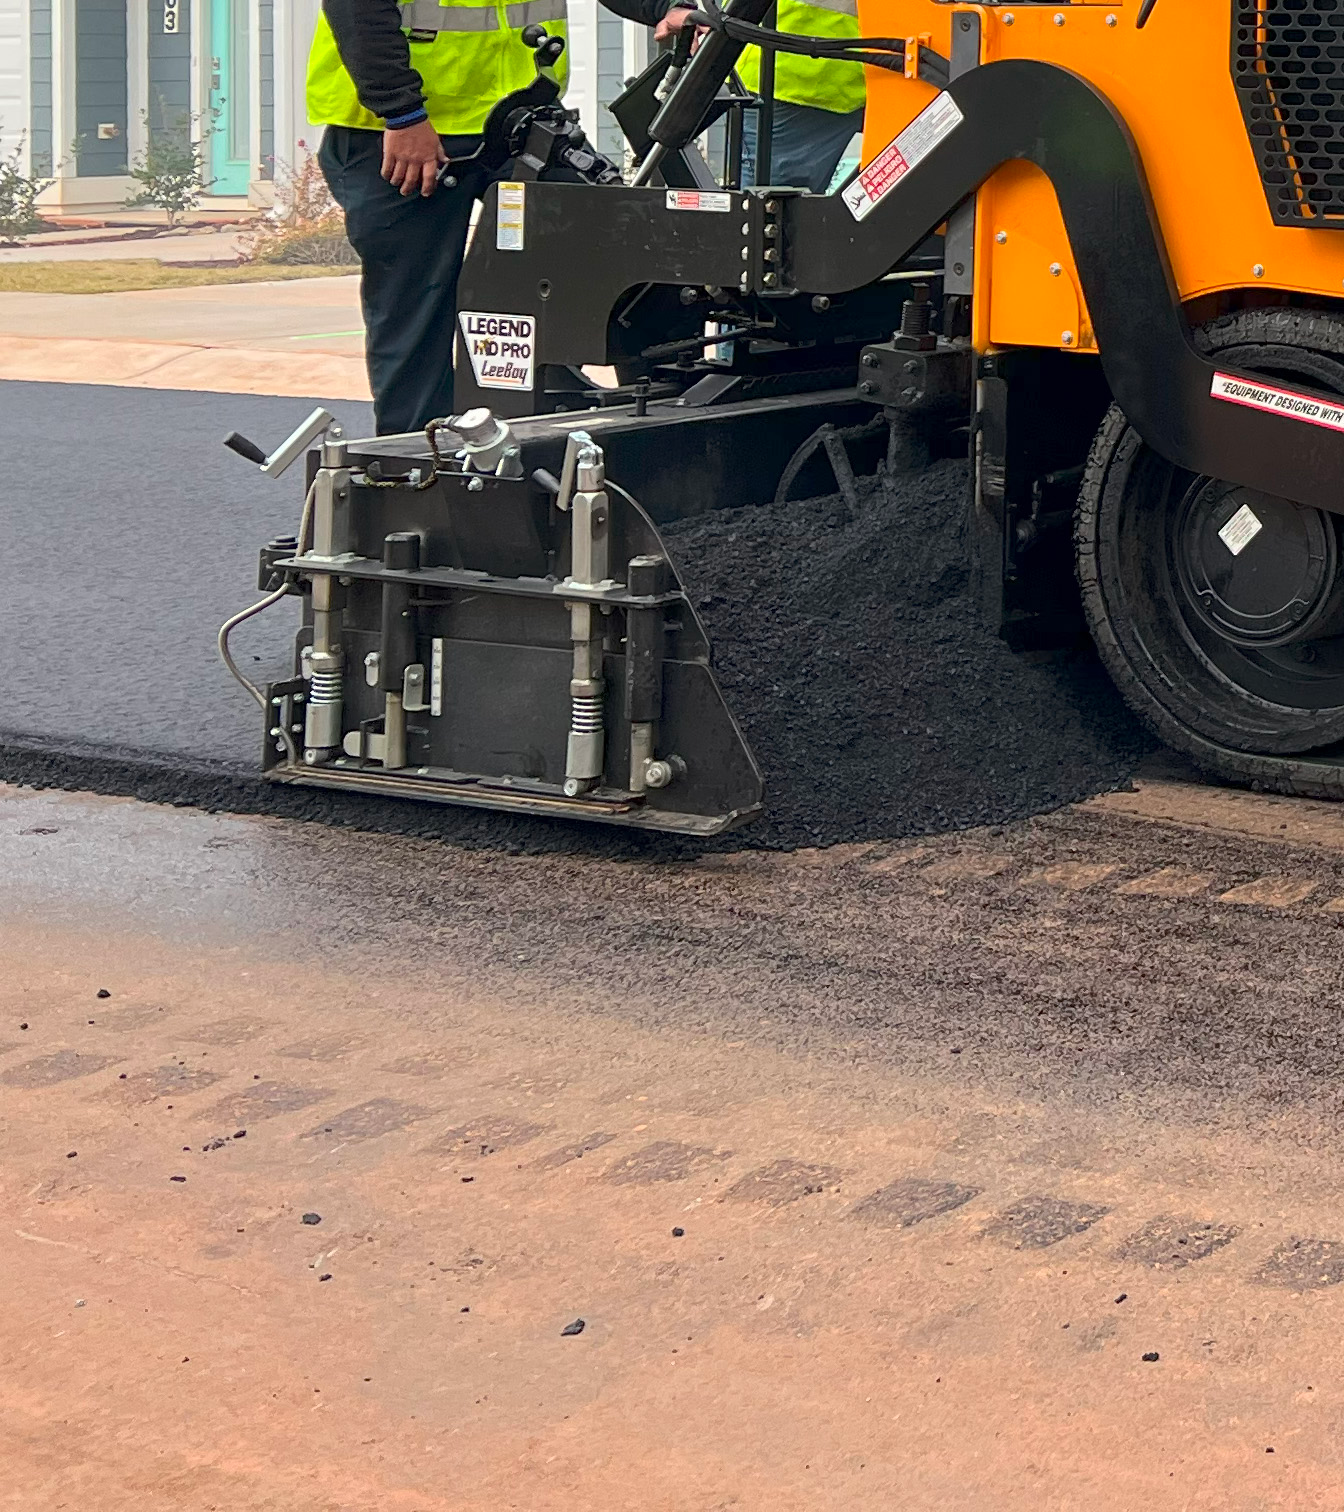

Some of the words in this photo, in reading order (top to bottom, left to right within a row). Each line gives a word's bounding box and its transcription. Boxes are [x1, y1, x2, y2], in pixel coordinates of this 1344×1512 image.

[867, 147, 897, 177] DANGER
[876, 163, 907, 194] DANGER
[467, 317, 531, 338] LEGEND
[501, 342, 531, 358] PRO
[481, 360, 528, 384] LeeBoy
[1275, 396, 1320, 416] DESIGNED
[1320, 408, 1344, 423] WITH
